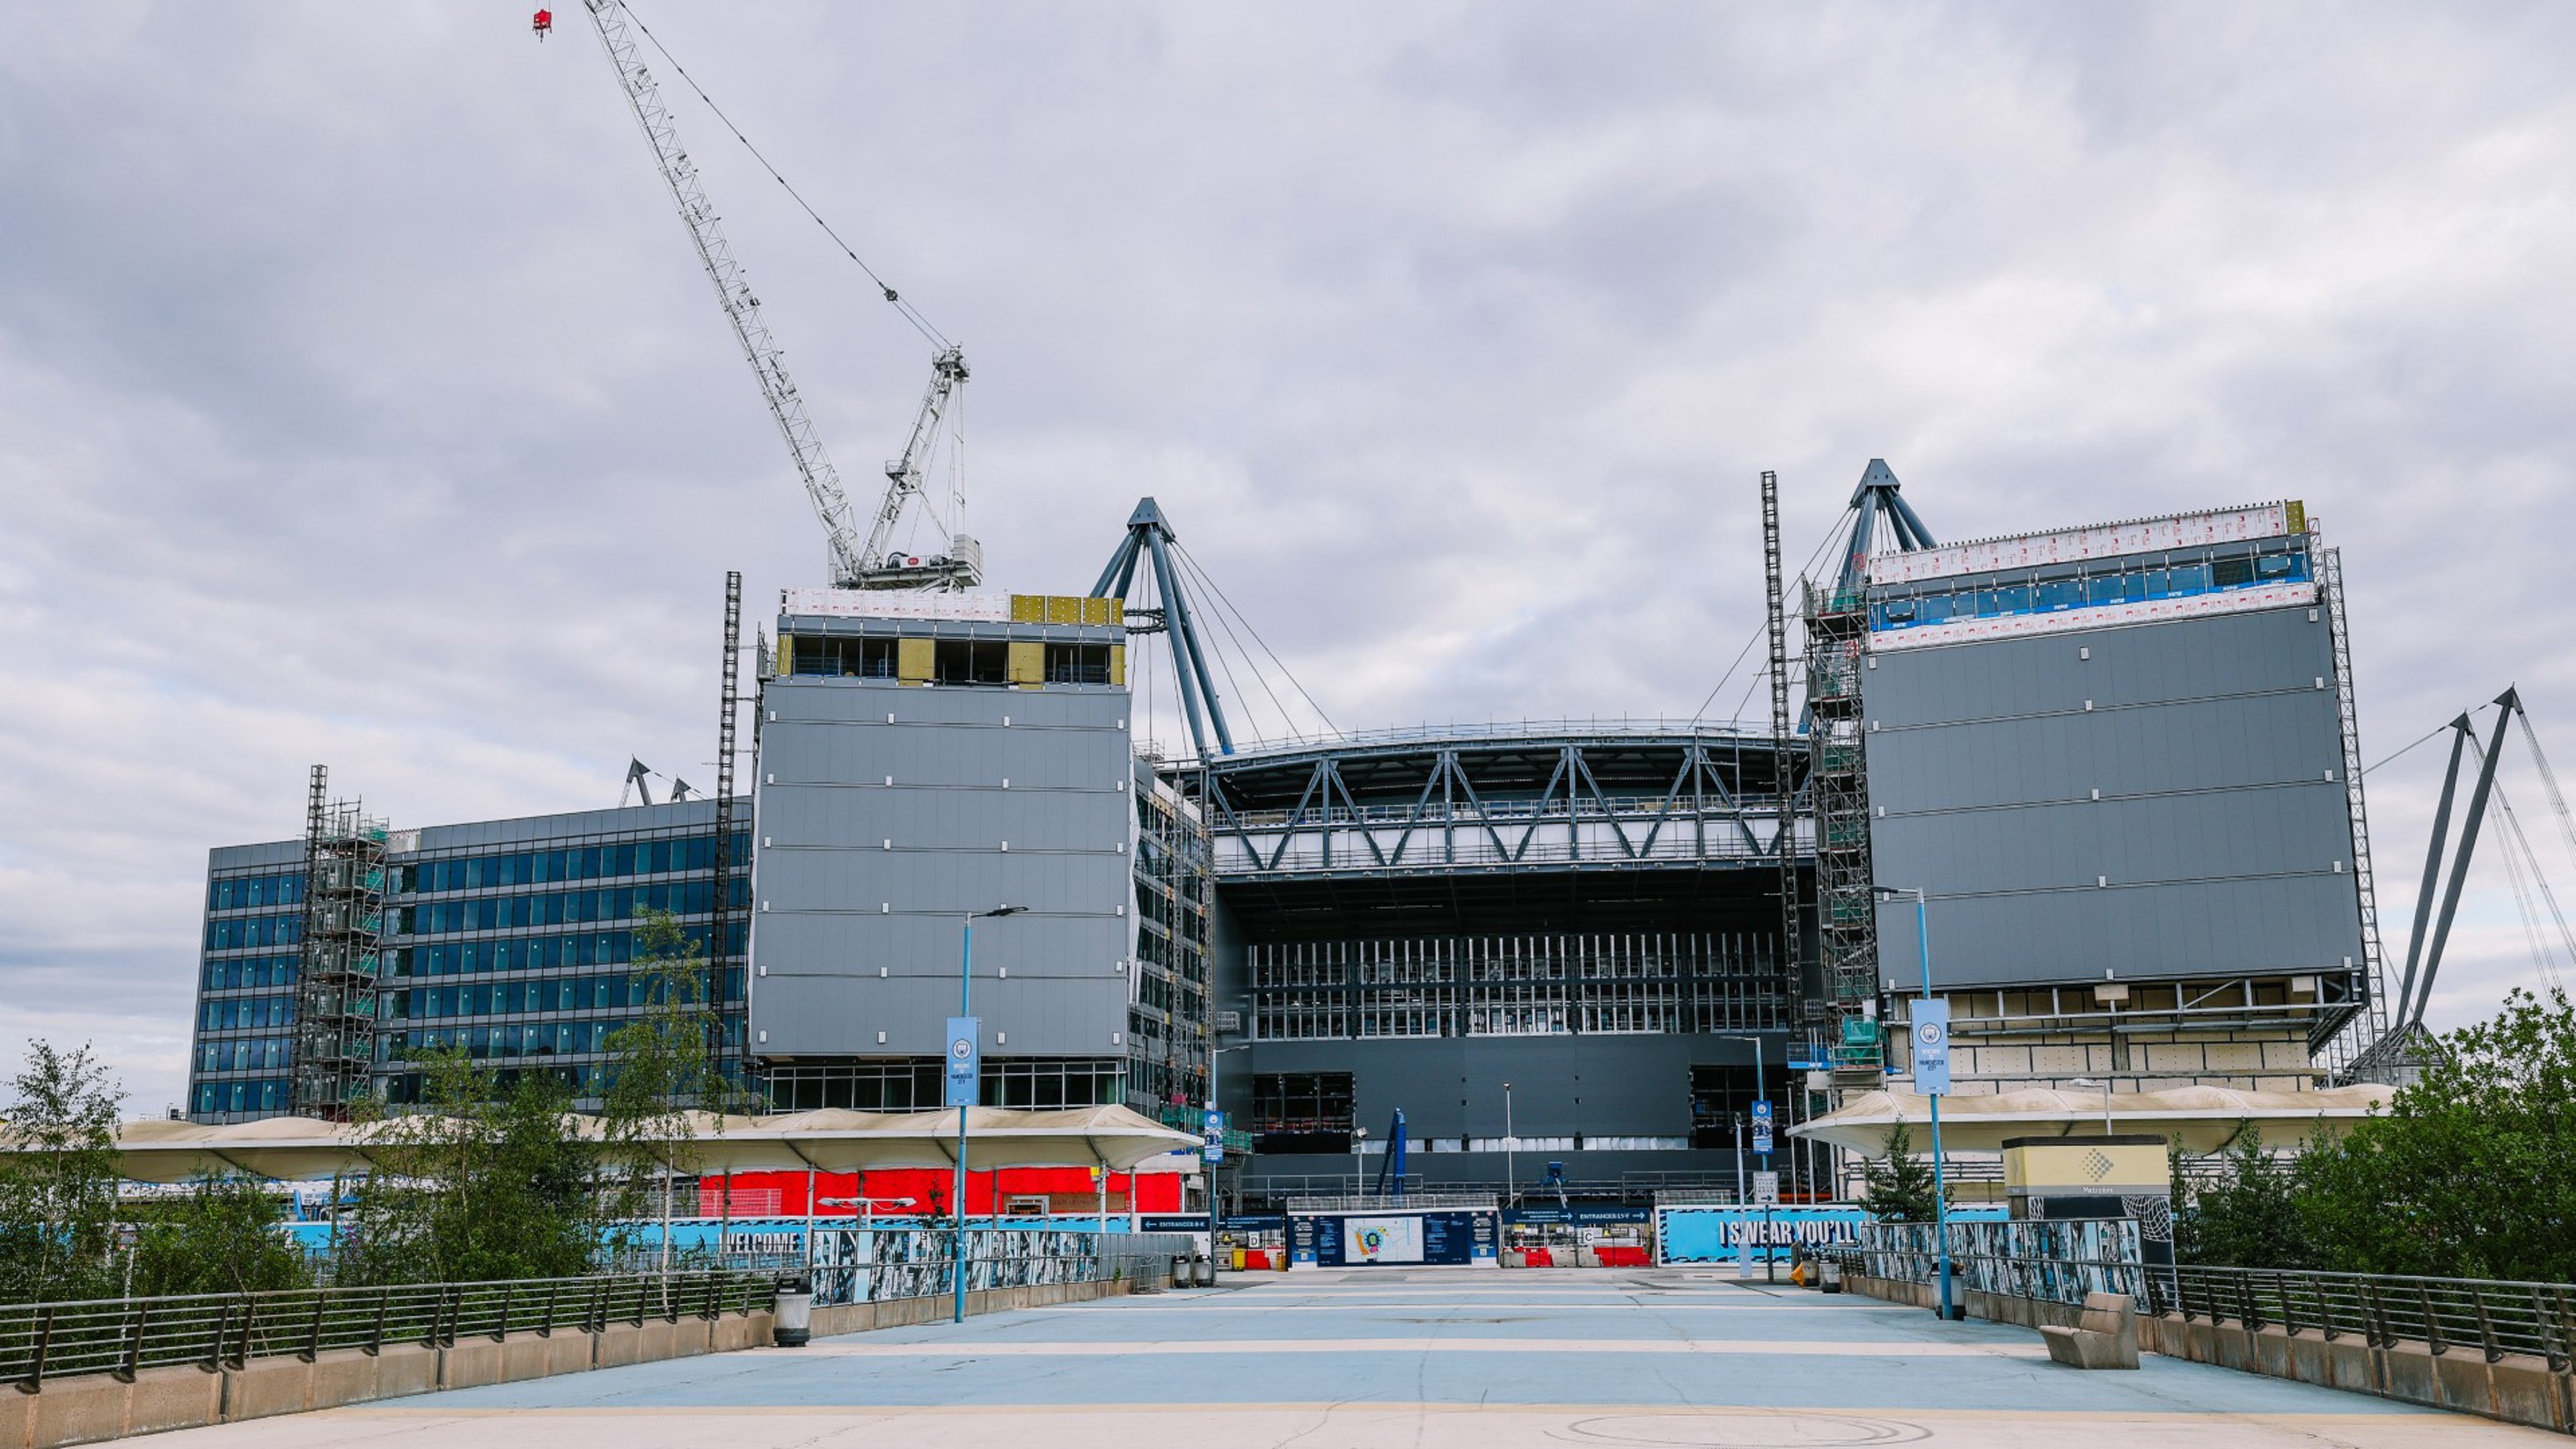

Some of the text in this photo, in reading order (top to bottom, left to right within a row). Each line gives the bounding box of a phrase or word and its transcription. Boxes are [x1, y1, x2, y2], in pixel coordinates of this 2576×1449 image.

[718, 1233, 800, 1254] WELCOME
[1719, 1221, 1725, 1245] I
[1729, 1220, 1794, 1245] SWEAR
